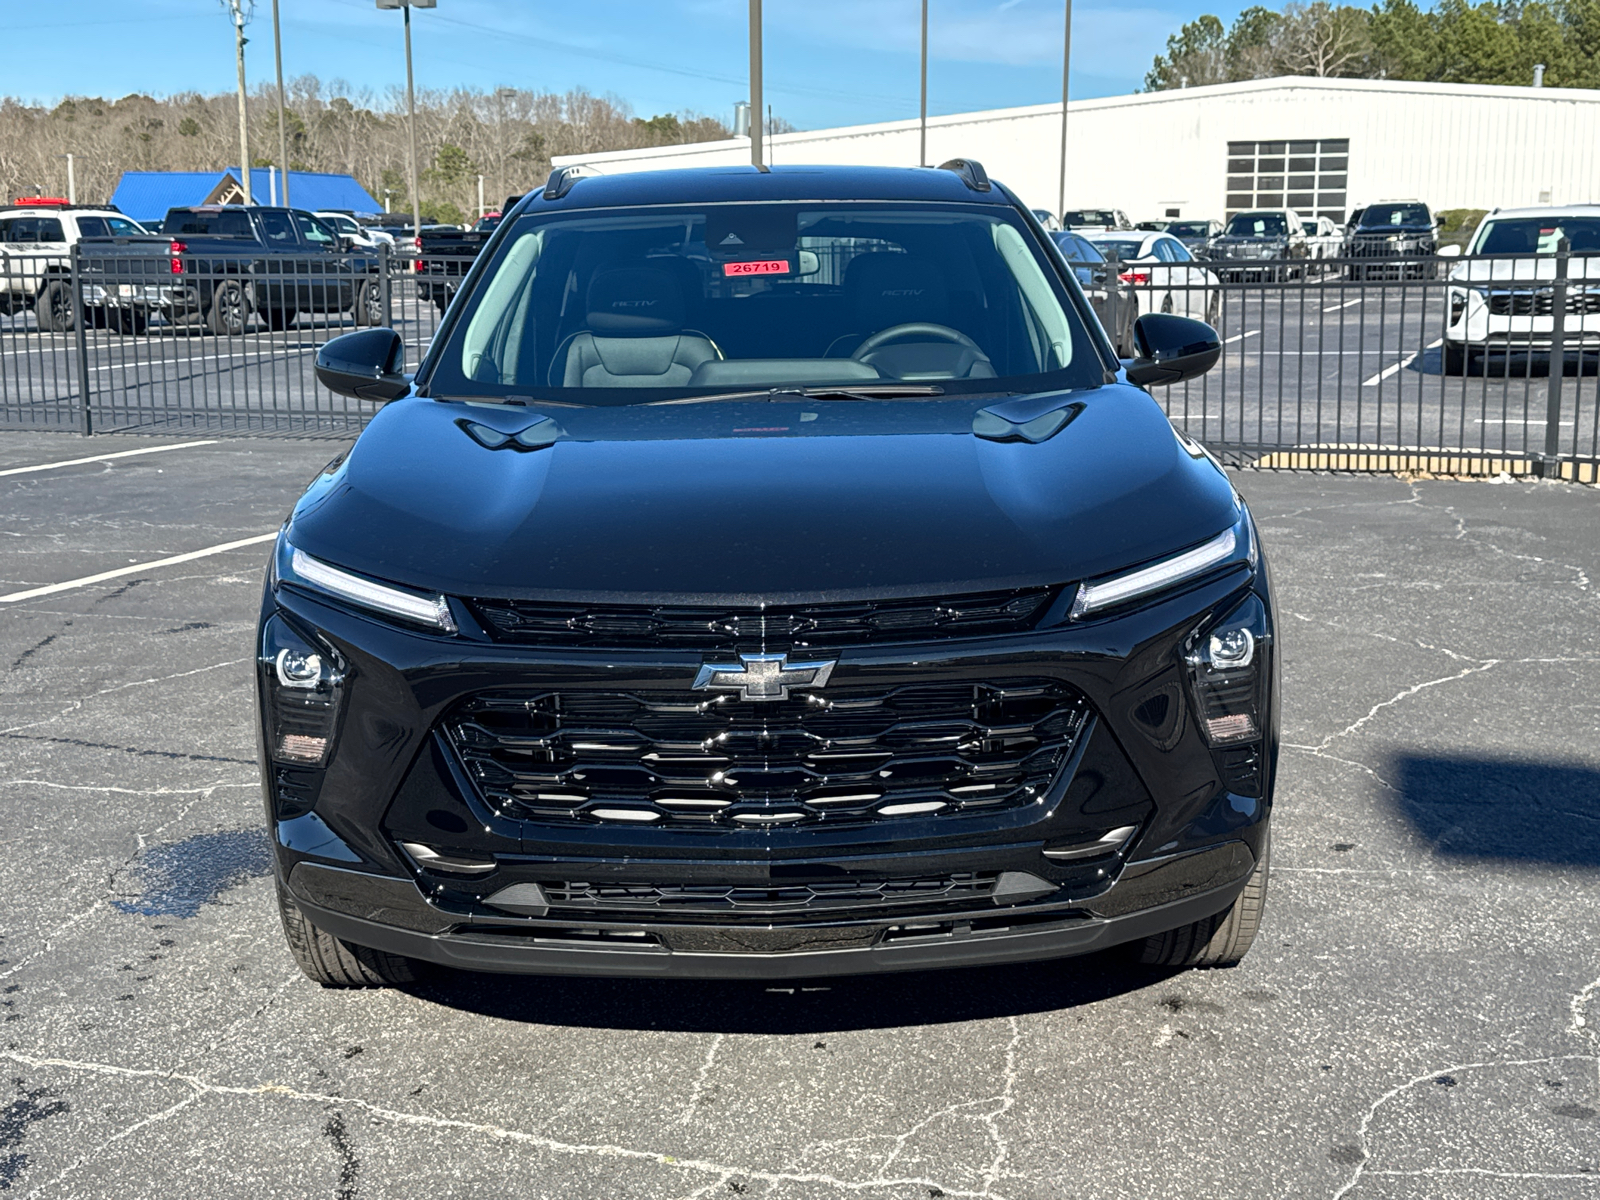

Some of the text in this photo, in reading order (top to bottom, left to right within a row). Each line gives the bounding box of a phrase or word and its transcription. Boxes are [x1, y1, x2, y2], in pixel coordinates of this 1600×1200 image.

[733, 262, 780, 273] 26719
[881, 288, 925, 297] ACTIV
[612, 299, 659, 308] ACTIV
